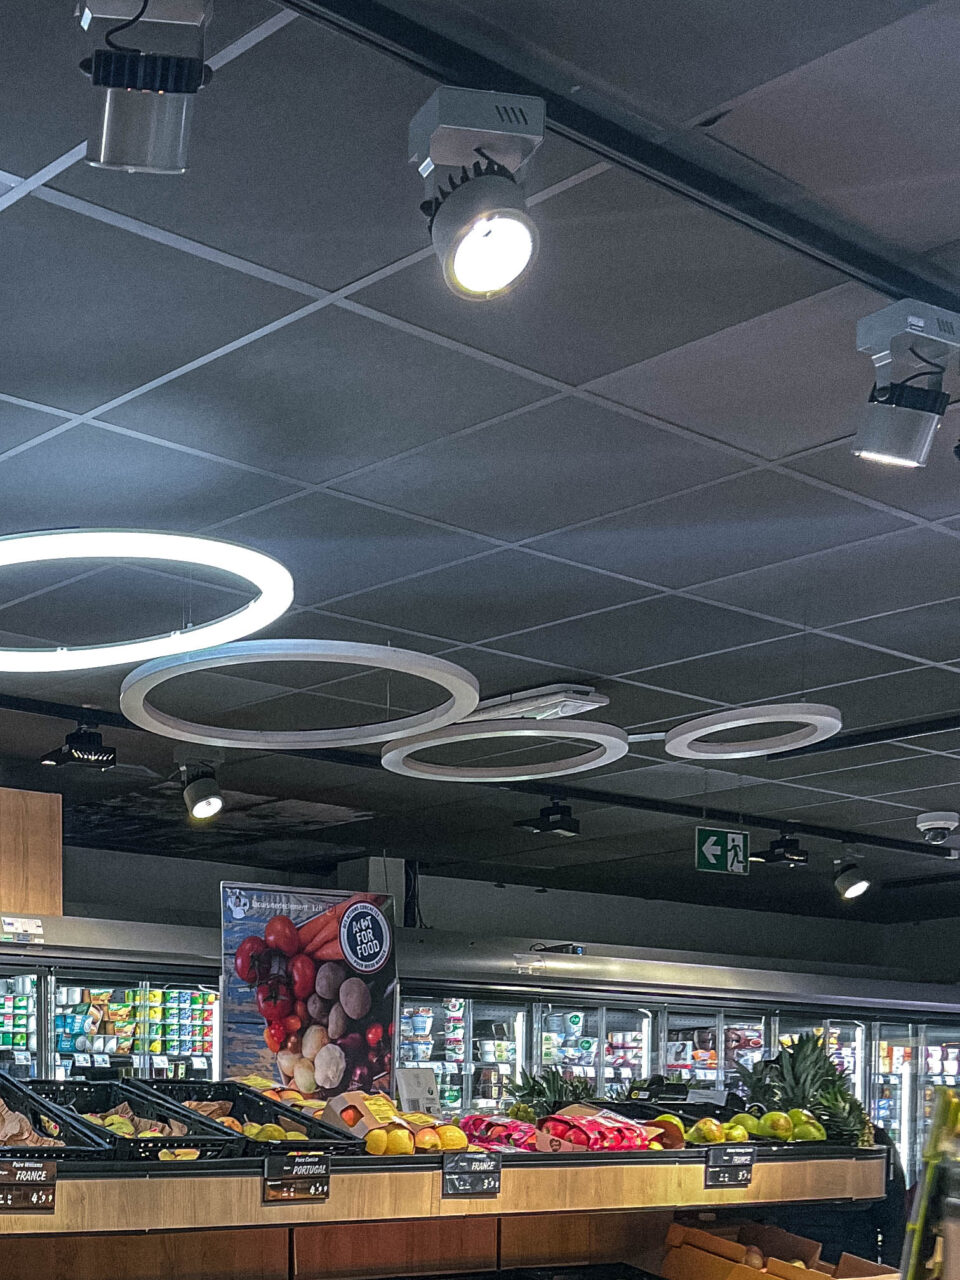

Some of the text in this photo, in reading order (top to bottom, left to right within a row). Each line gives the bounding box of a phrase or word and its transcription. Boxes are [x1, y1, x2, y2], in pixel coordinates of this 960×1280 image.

[356, 929, 375, 945] FOR
[356, 940, 380, 958] FOOD
[292, 1164, 326, 1175] PORTUGAL
[471, 1161, 496, 1170] FRANCE
[15, 1170, 47, 1181] FRANCE
